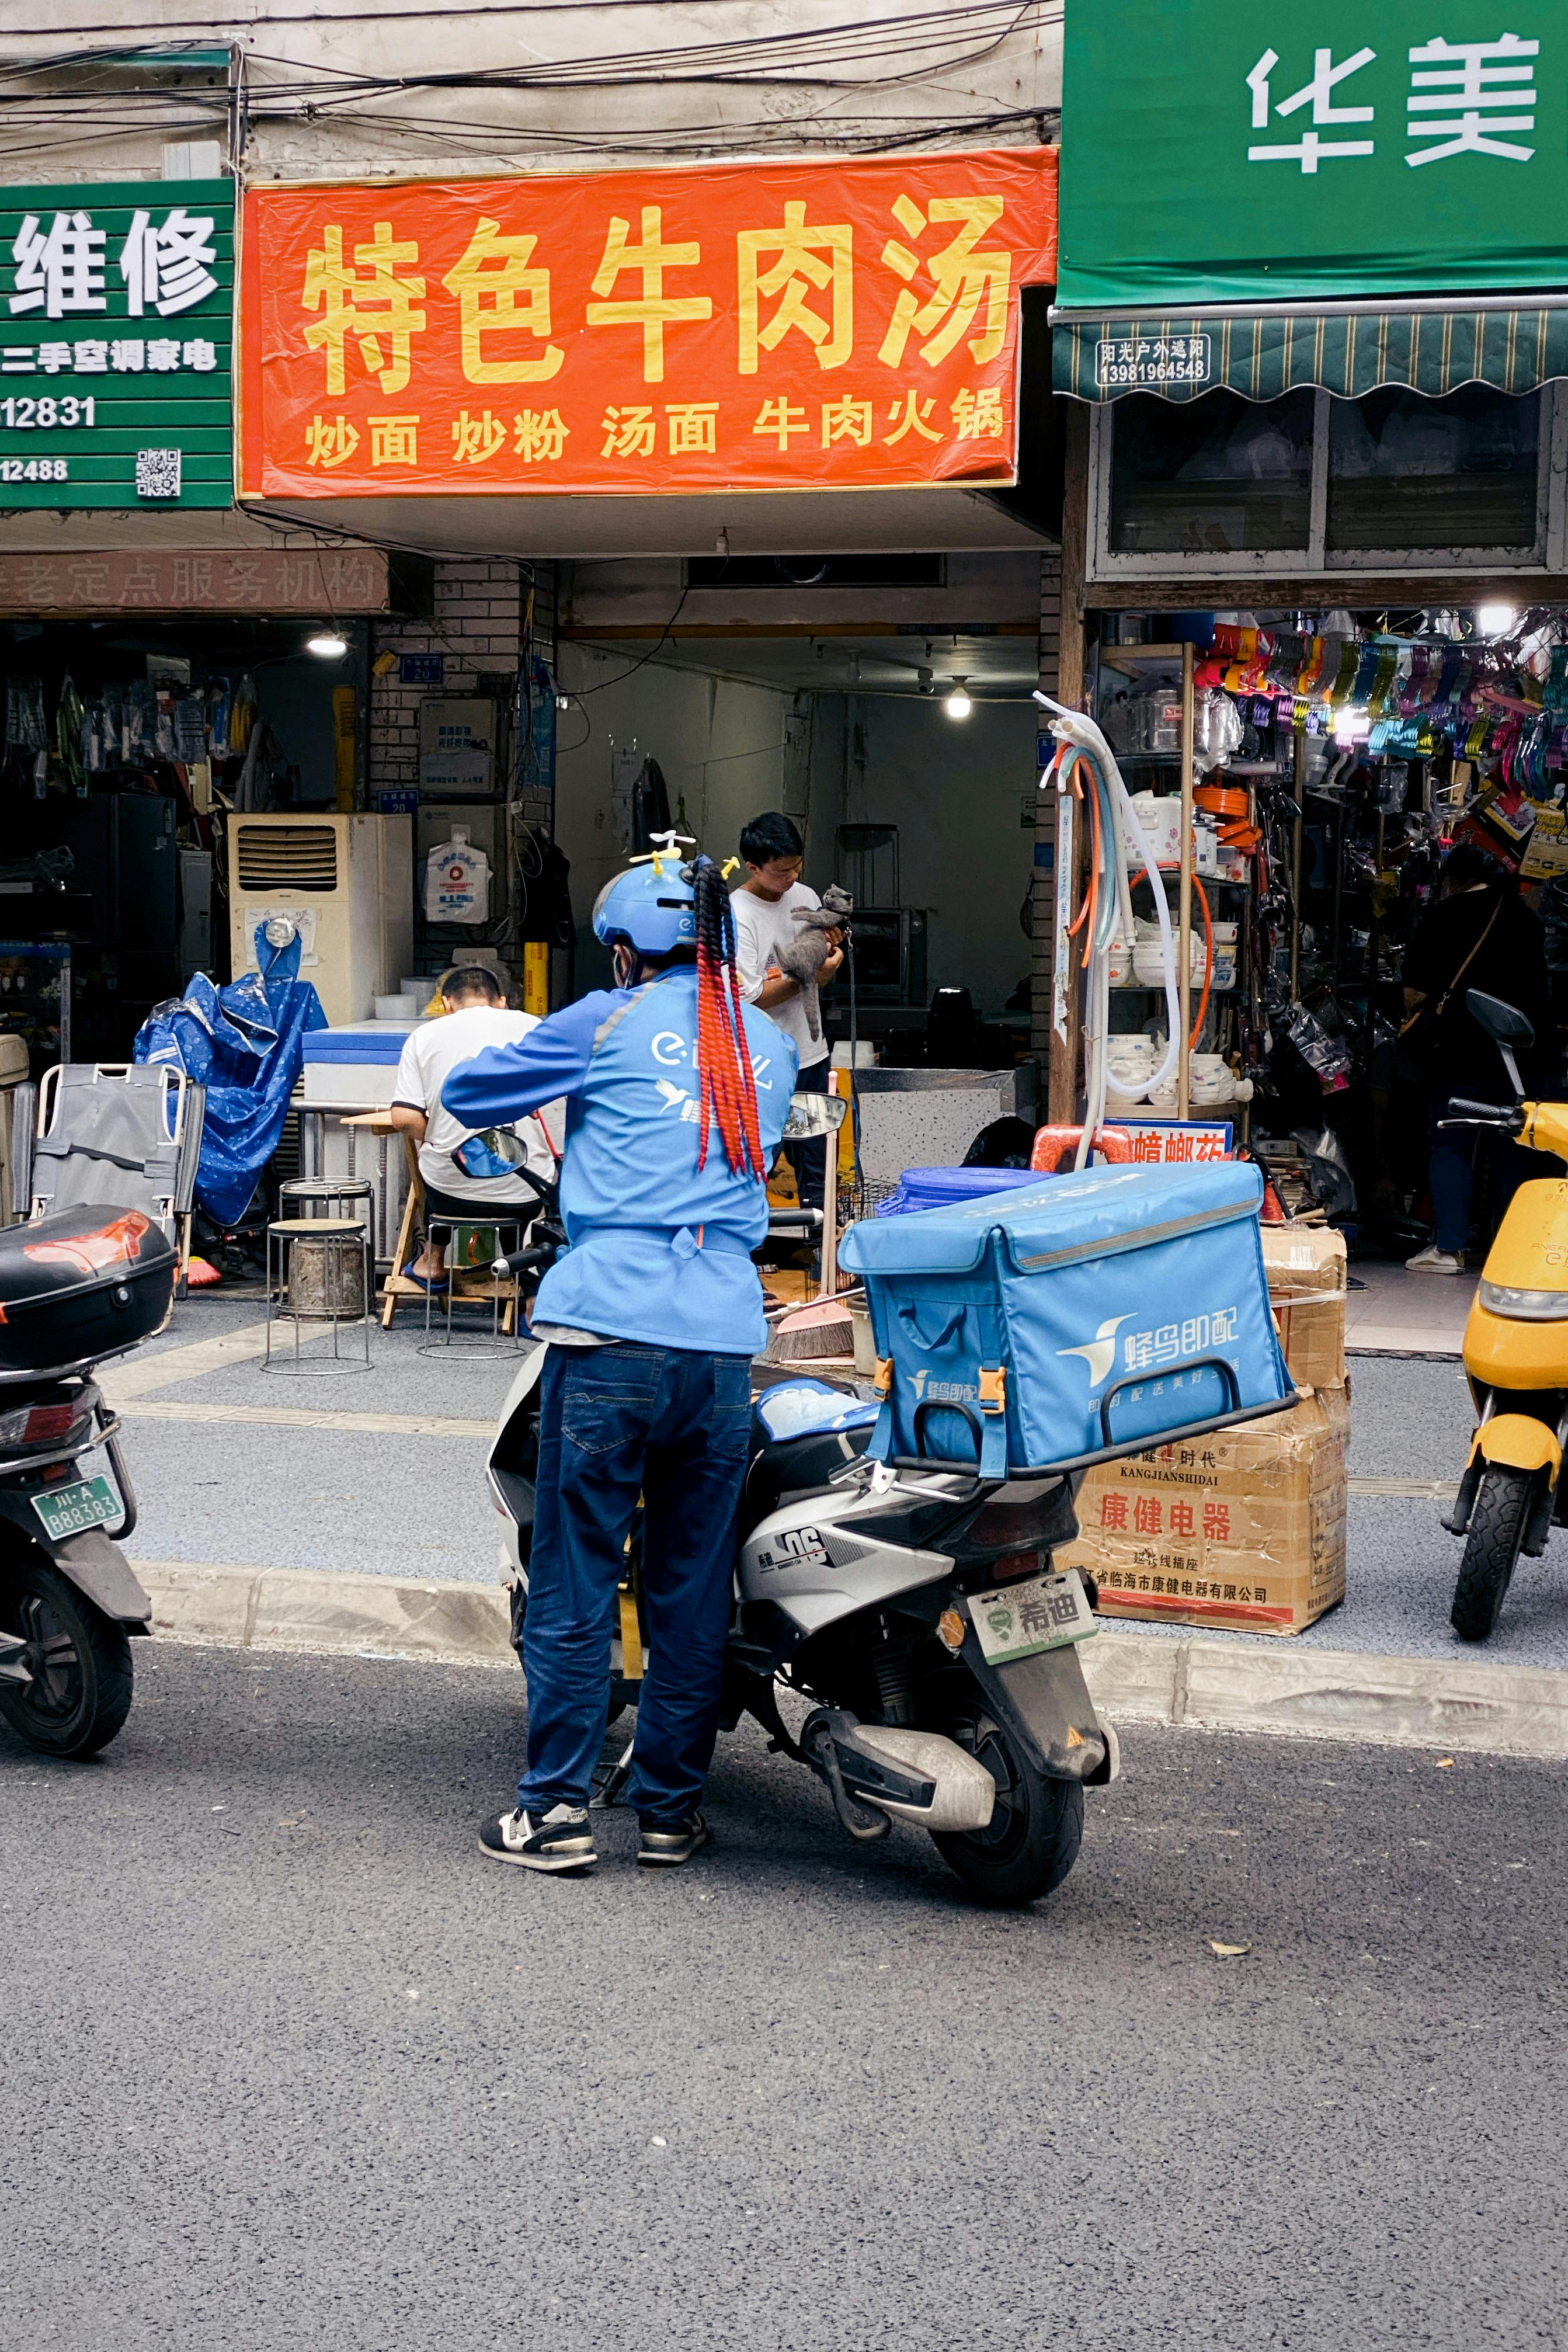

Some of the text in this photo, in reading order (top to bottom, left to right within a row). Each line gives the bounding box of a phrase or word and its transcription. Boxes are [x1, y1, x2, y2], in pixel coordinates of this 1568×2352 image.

[1246, 32, 1540, 173] 华美
[9, 209, 219, 318] 维修
[302, 194, 1012, 396] 特色牛肉汤
[1, 339, 217, 373] 二手空调家电
[1101, 339, 1204, 363] 阳光户外遮阳
[1101, 360, 1204, 383] 13981964548
[0, 396, 95, 427] 12831
[304, 387, 1004, 467] 炒面 炒粉 汤面 牛肉火锅
[0, 557, 374, 605] 老定点服务机构
[1132, 1131, 1225, 1163] 蟑螂药
[1125, 1307, 1239, 1373] 蜂鸟即配
[927, 1381, 981, 1402] 蜂鸟即配
[1121, 1467, 1218, 1486] KANGJIANSHIDAI
[48, 1496, 116, 1533] B88383
[1100, 1492, 1230, 1541] 康健电器
[1134, 1551, 1198, 1571] 延长线插座
[1020, 1593, 1080, 1634] 希迪
